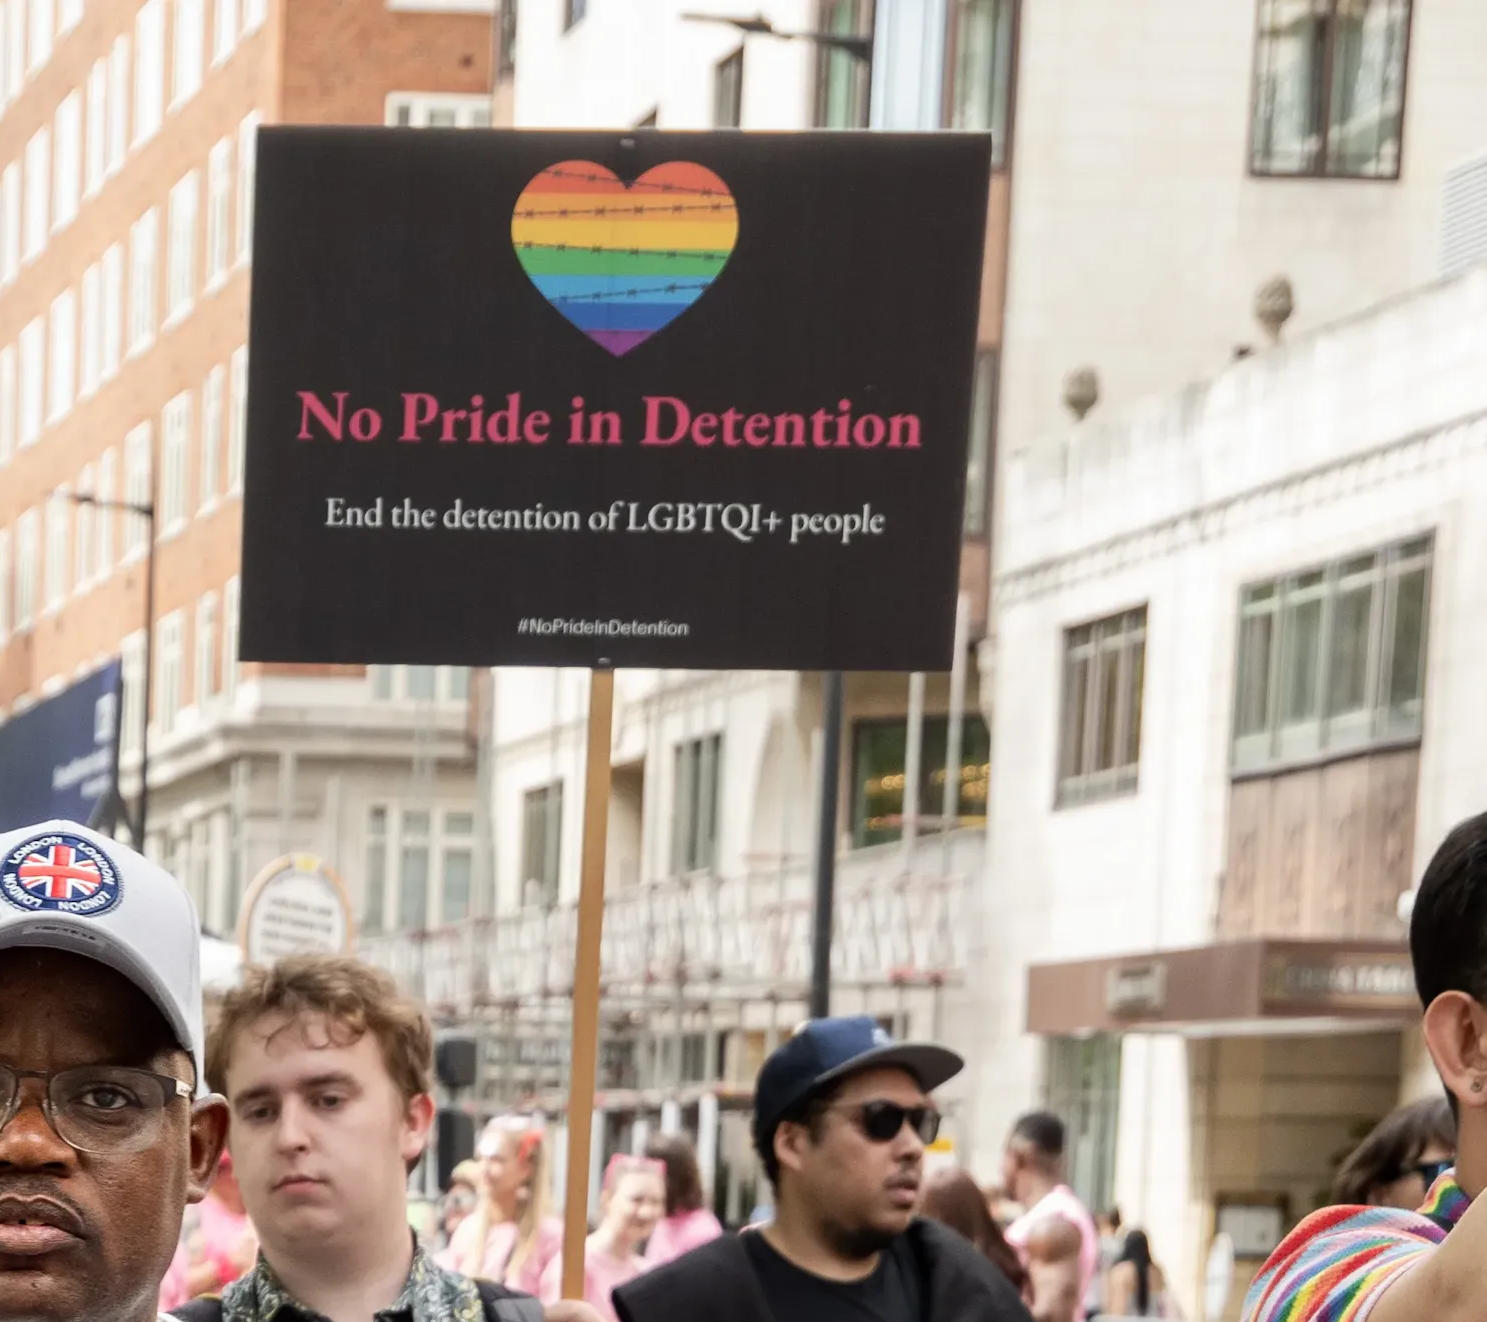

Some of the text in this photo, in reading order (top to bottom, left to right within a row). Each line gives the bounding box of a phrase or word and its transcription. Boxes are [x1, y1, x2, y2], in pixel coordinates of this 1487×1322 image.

[297, 390, 922, 448] No Pride in Detention
[324, 497, 886, 545] End the detention of LGBTQI+ people
[516, 617, 690, 637] #NoPrideInDetention
[7, 836, 63, 865] LONDON
[76, 842, 116, 885] LONDON
[2, 872, 43, 908] LONDON
[57, 890, 112, 912] LONDON
